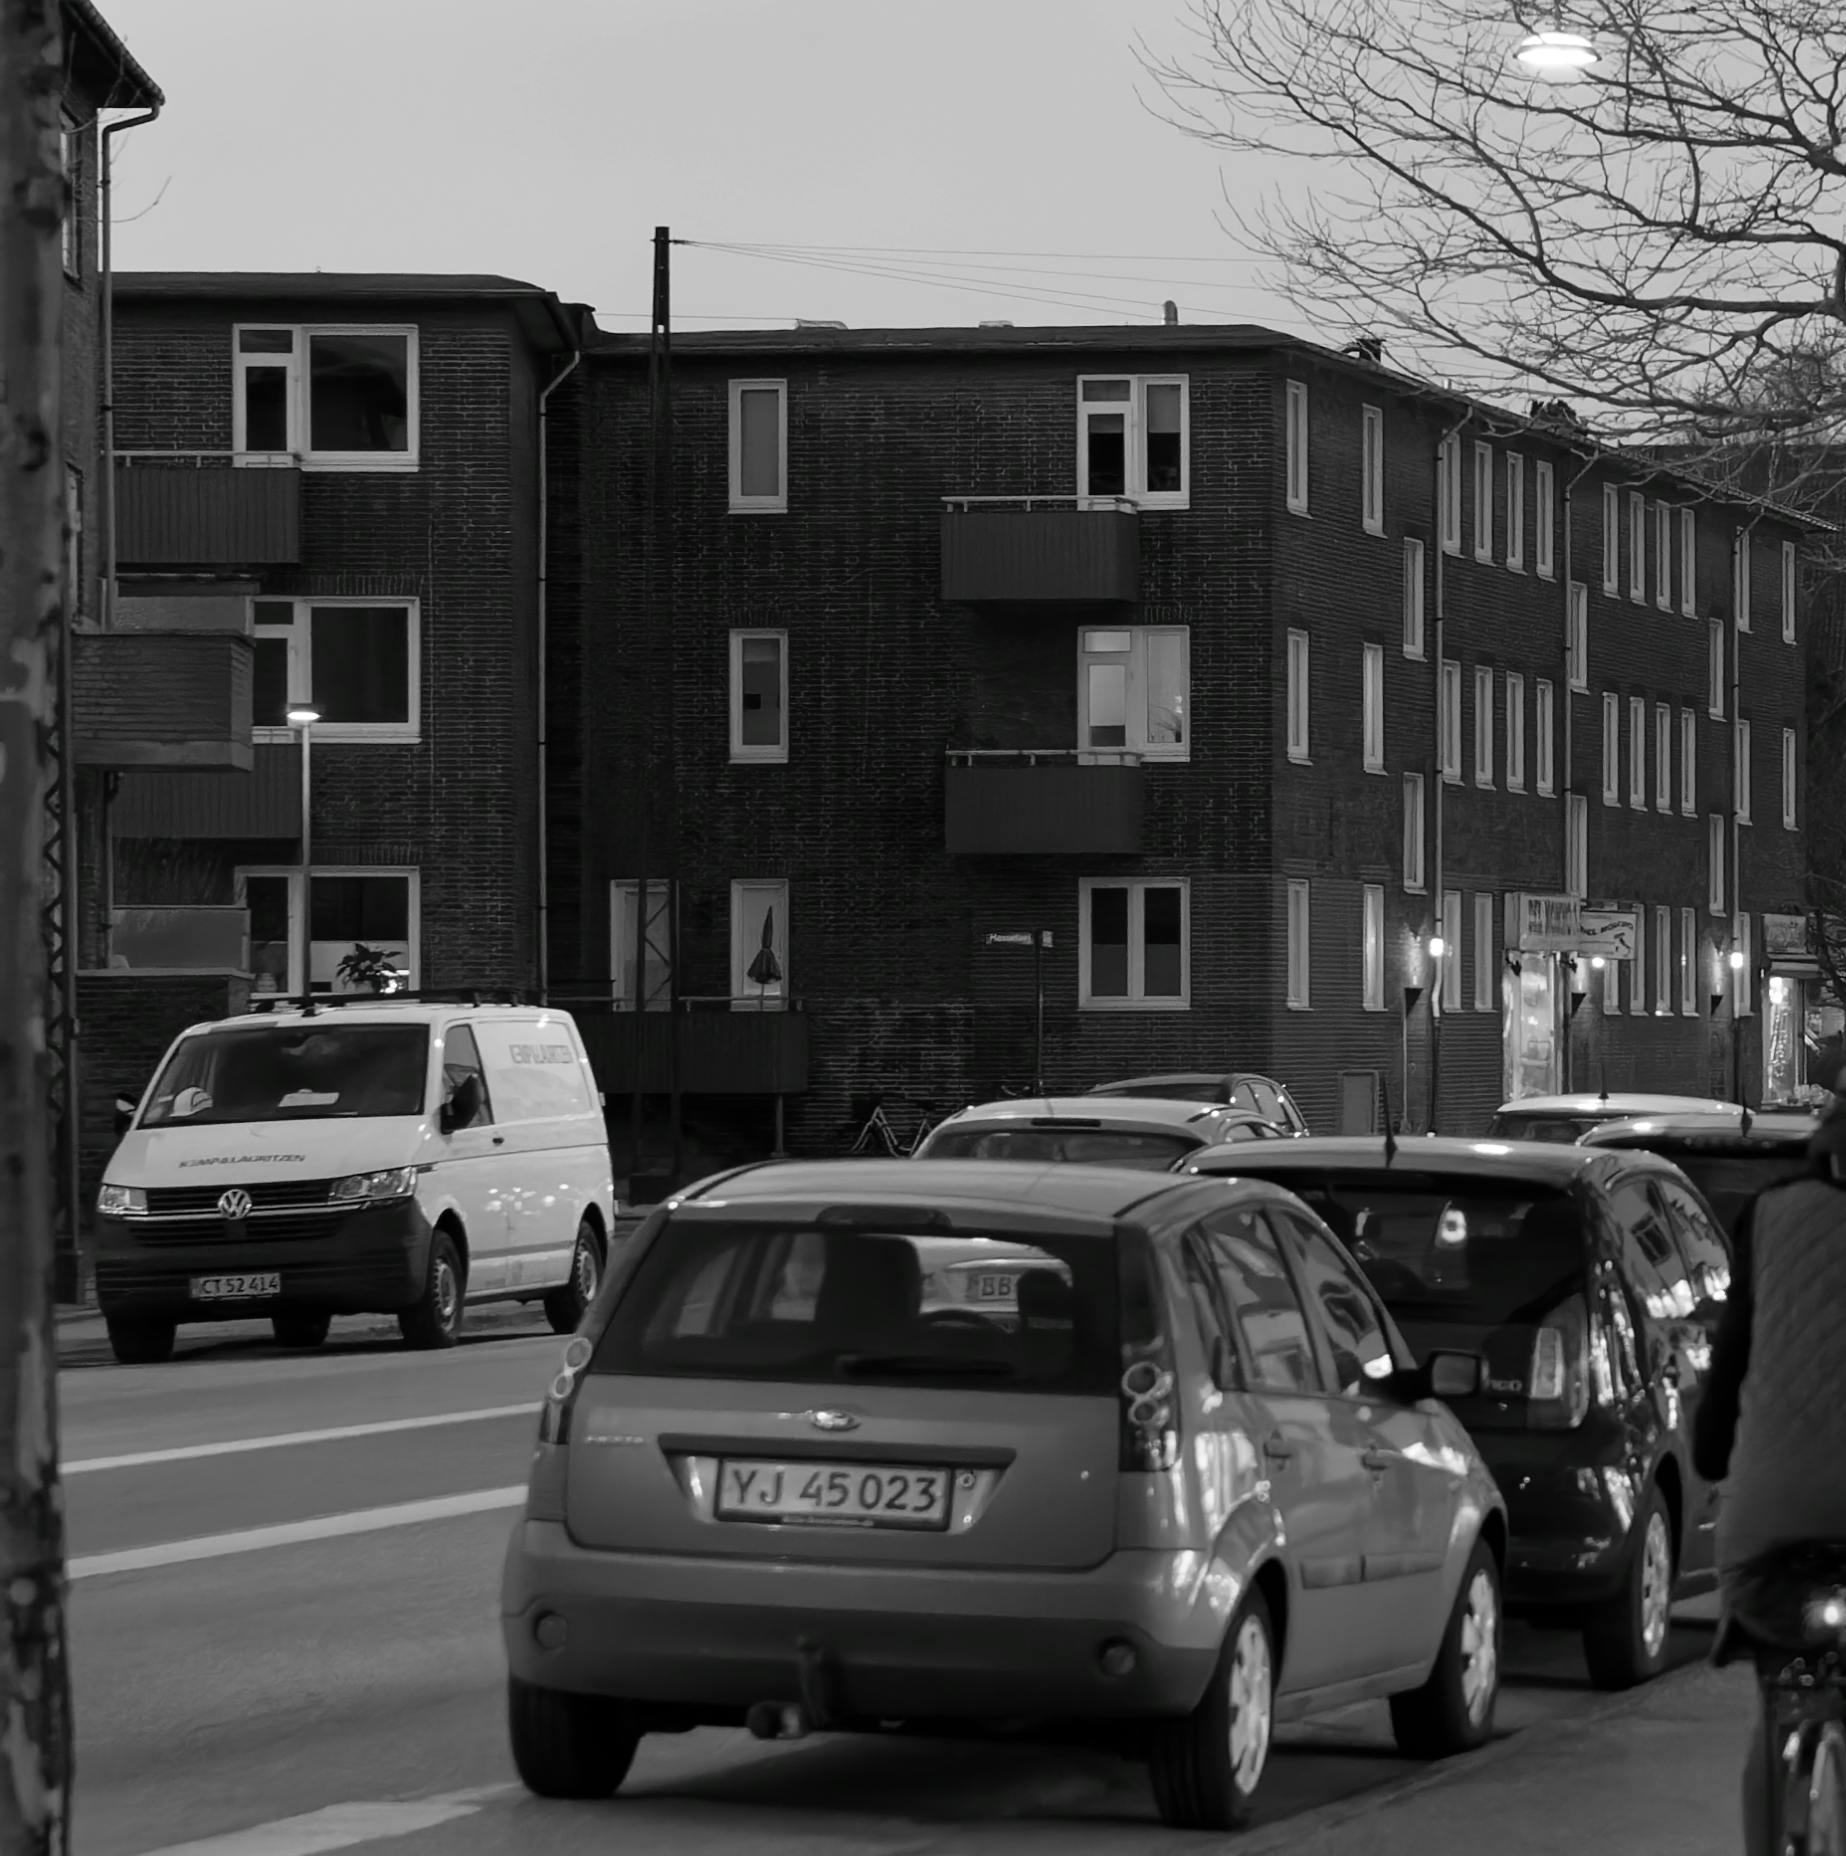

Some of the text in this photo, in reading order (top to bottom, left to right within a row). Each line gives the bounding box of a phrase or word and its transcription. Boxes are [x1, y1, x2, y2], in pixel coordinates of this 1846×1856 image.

[226, 1278, 245, 1293] 52
[733, 1469, 937, 1512] YJ 45 023
